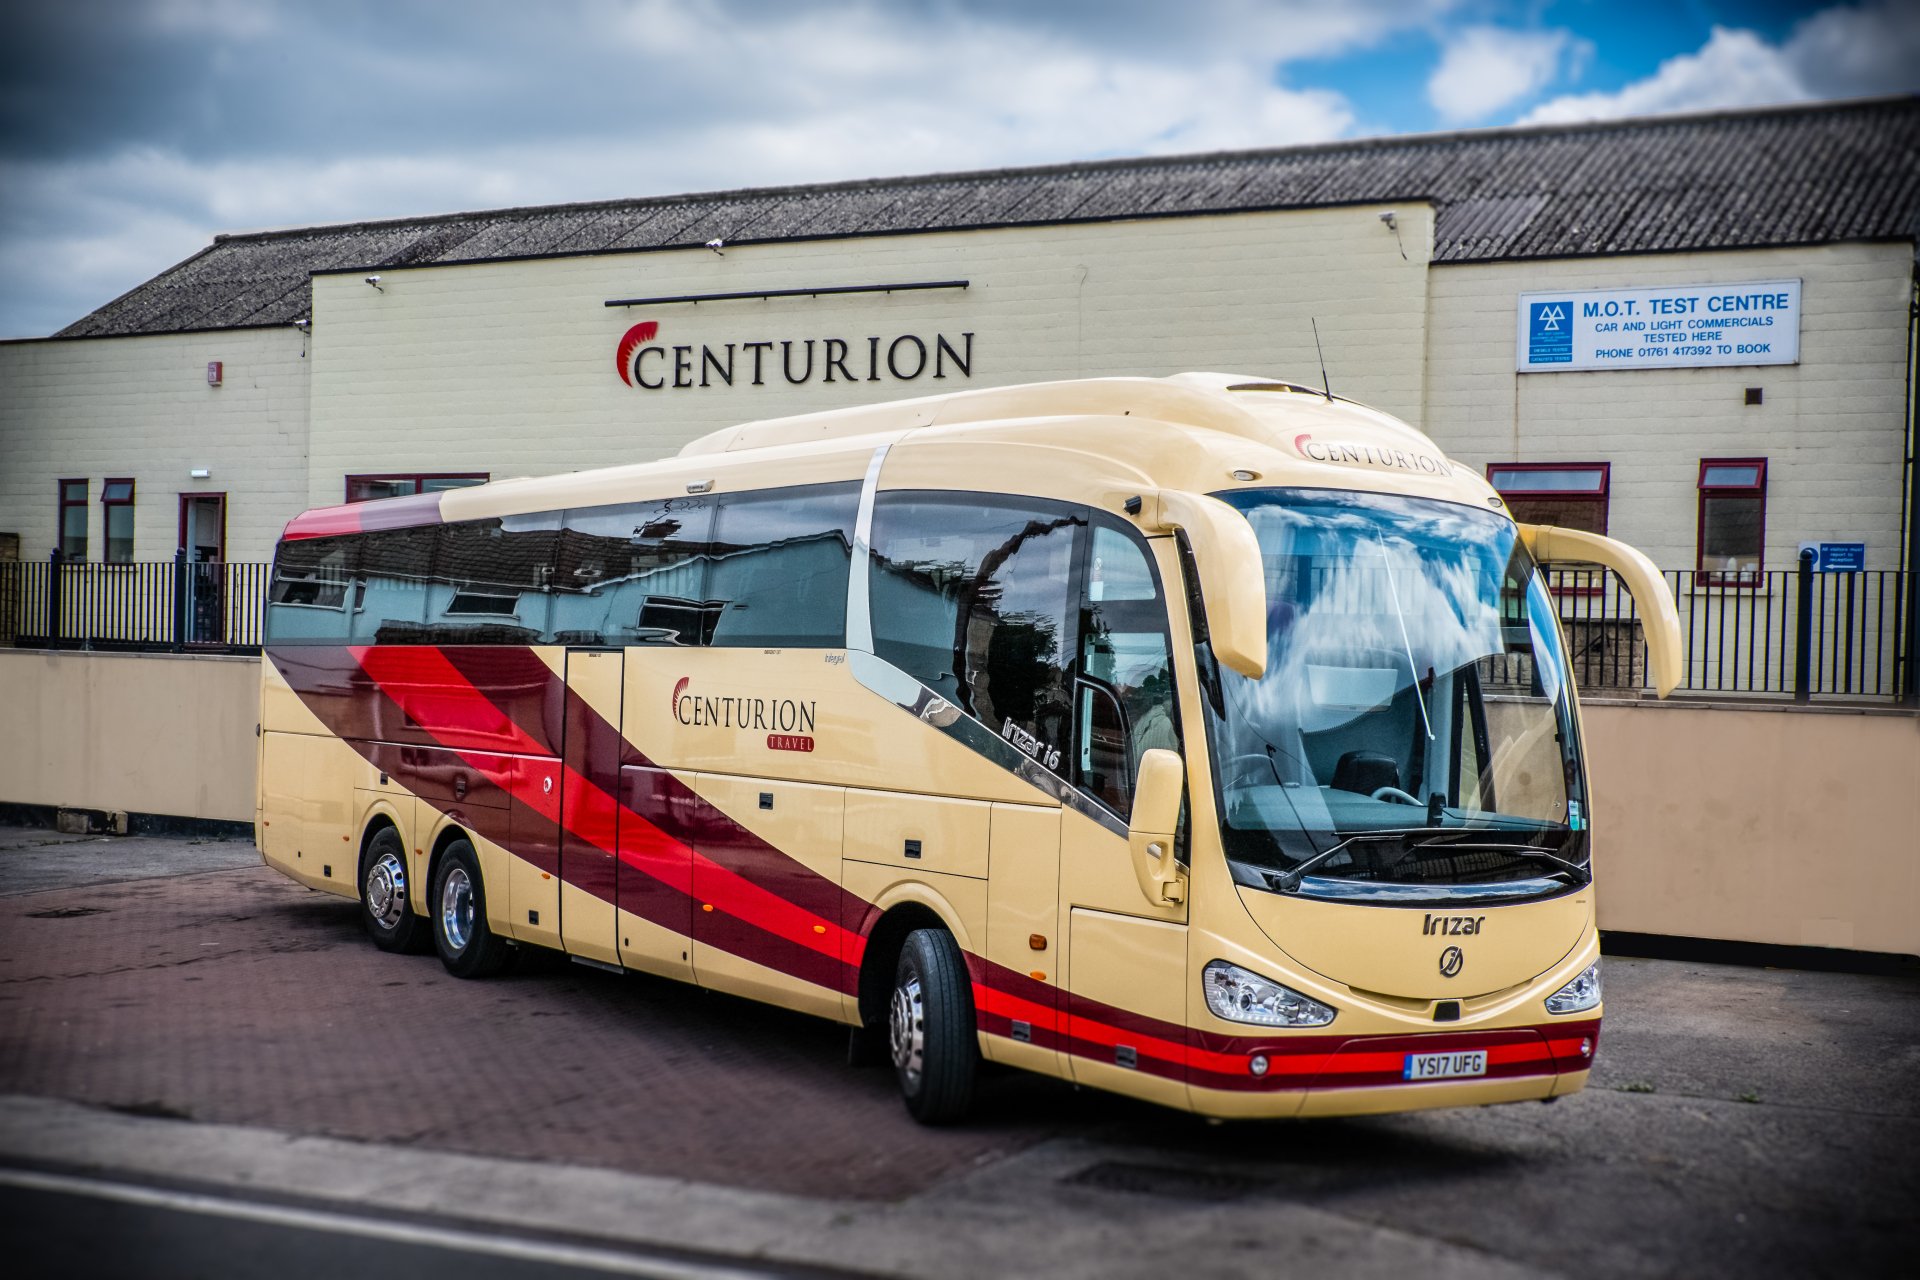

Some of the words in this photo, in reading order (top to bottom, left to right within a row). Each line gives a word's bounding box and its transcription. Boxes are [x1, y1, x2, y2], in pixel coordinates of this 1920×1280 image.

[1583, 300, 1640, 318] M.O.T.
[1649, 298, 1700, 316] TEST
[1707, 293, 1790, 313] CENTRE
[1595, 322, 1618, 333] CAR
[1622, 321, 1646, 332] AND
[1650, 319, 1682, 331] LIGHT
[1687, 316, 1774, 330] COMMERCIALS
[1643, 331, 1688, 344] TESTED
[1691, 330, 1723, 342] HERE
[633, 332, 975, 390] CENTURION
[1595, 347, 1633, 359] PHONE
[1638, 346, 1669, 358] 01761
[1672, 345, 1712, 357] 417392
[1717, 344, 1733, 355] TO
[1736, 343, 1772, 354] BOOK
[1306, 442, 1455, 477] CENTURION
[678, 695, 817, 733] CENTURION
[769, 736, 813, 751] TRAVEL
[1042, 744, 1062, 770] i6
[1422, 913, 1486, 936] Irizar
[1417, 1056, 1450, 1076] YS17
[1453, 1054, 1482, 1075] UFG
